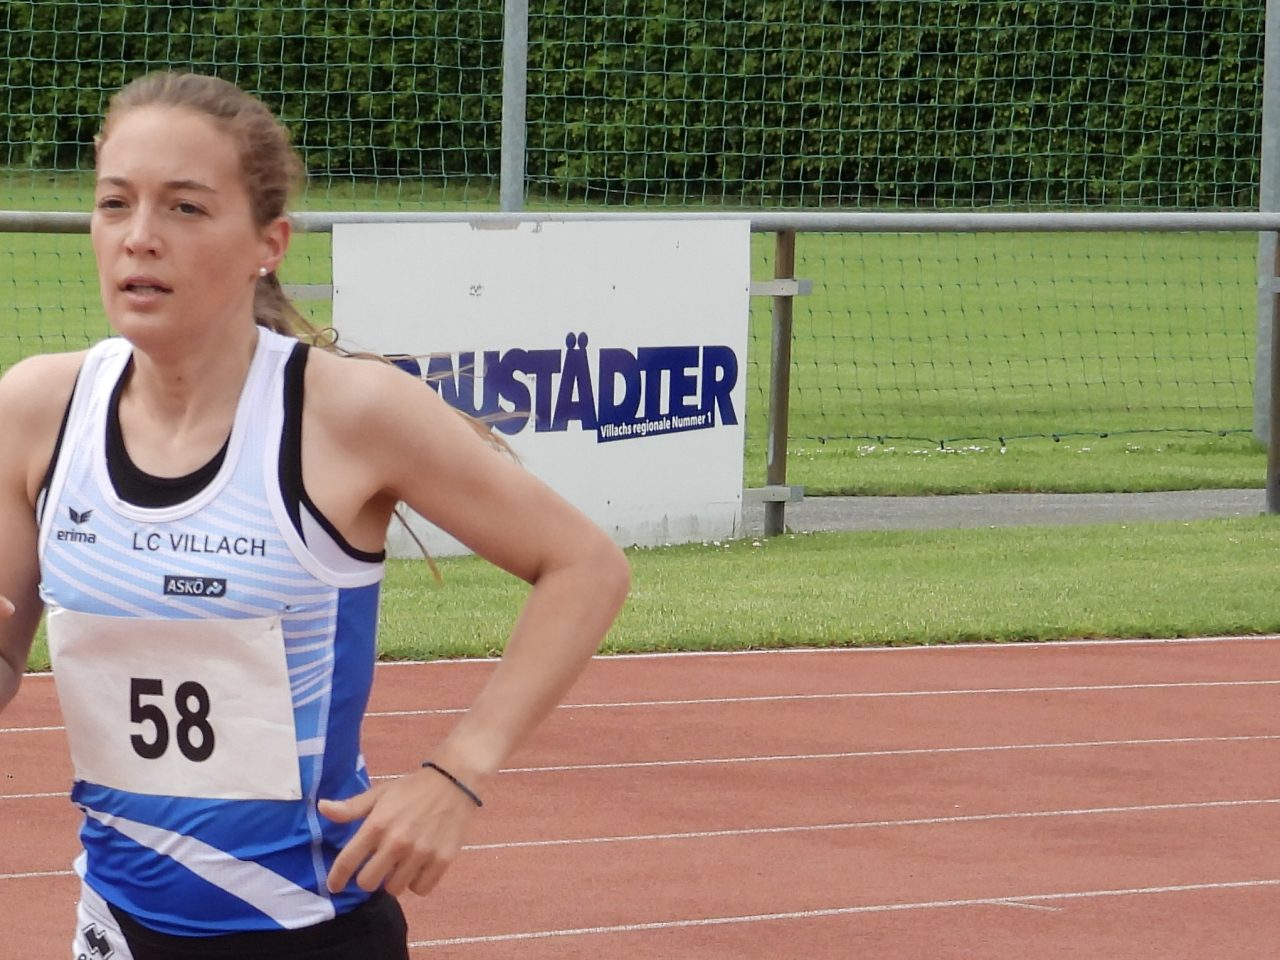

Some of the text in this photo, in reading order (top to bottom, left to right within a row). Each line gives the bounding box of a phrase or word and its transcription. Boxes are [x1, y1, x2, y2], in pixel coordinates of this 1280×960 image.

[600, 411, 712, 437] Villachs regionale Nummer 1
[56, 529, 96, 544] erima
[132, 532, 267, 557] LC VILLACH
[167, 577, 204, 595] ASKÖ
[129, 677, 216, 763] 58
